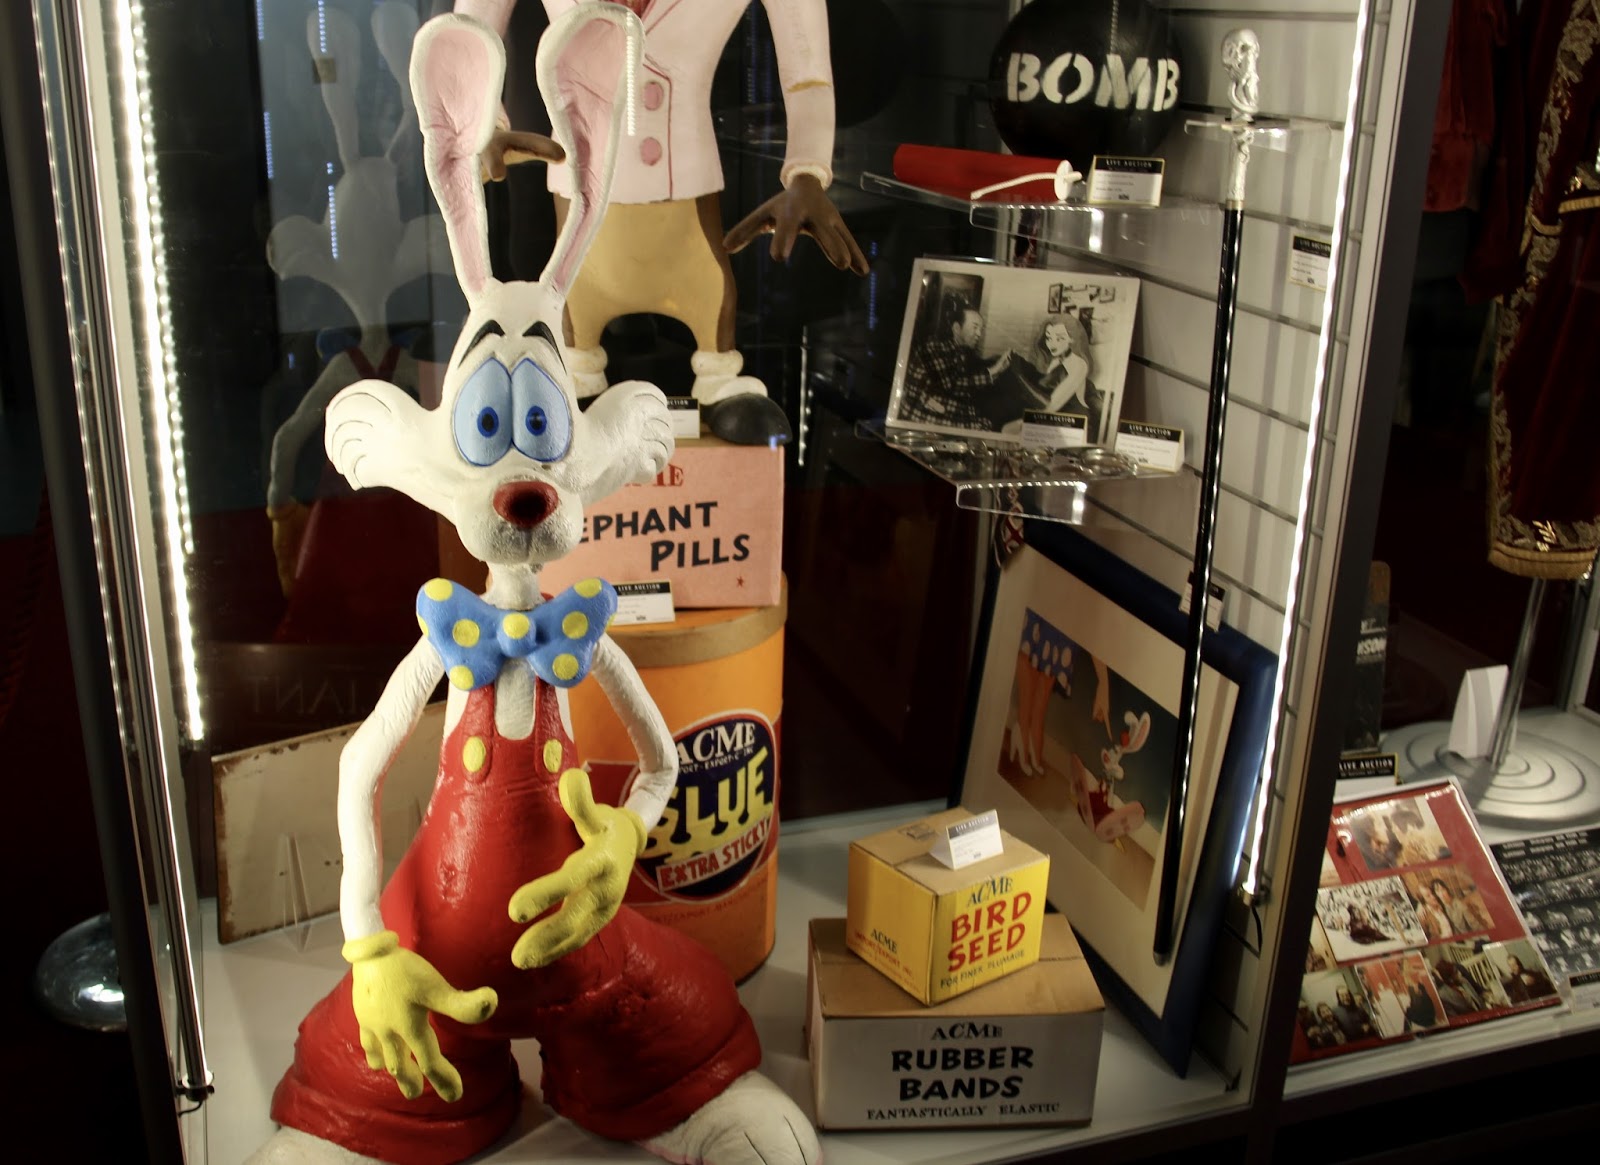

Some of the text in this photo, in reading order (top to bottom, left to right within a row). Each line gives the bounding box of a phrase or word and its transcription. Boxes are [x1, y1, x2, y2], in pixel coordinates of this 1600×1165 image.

[1006, 52, 1181, 112] BOMB
[1124, 160, 1152, 168] AUCTION
[1129, 424, 1172, 436] LIVE AUCTION
[650, 534, 750, 572] PILLS
[676, 722, 756, 765] ACME
[1338, 758, 1393, 771] LIVE AUCTION
[659, 852, 720, 888] EXTRA
[967, 876, 1013, 906] ACME
[951, 892, 1032, 943] BIRD
[870, 928, 898, 954] ACME
[947, 923, 1026, 973] SEED
[940, 949, 1025, 988] FOR FINER PLUMAGE
[931, 1021, 1003, 1040] ACME
[891, 1046, 1034, 1071] RUBBER
[900, 1075, 1023, 1101] BANDS
[866, 1103, 1060, 1120] FANTASTICALLY ELASTIC
